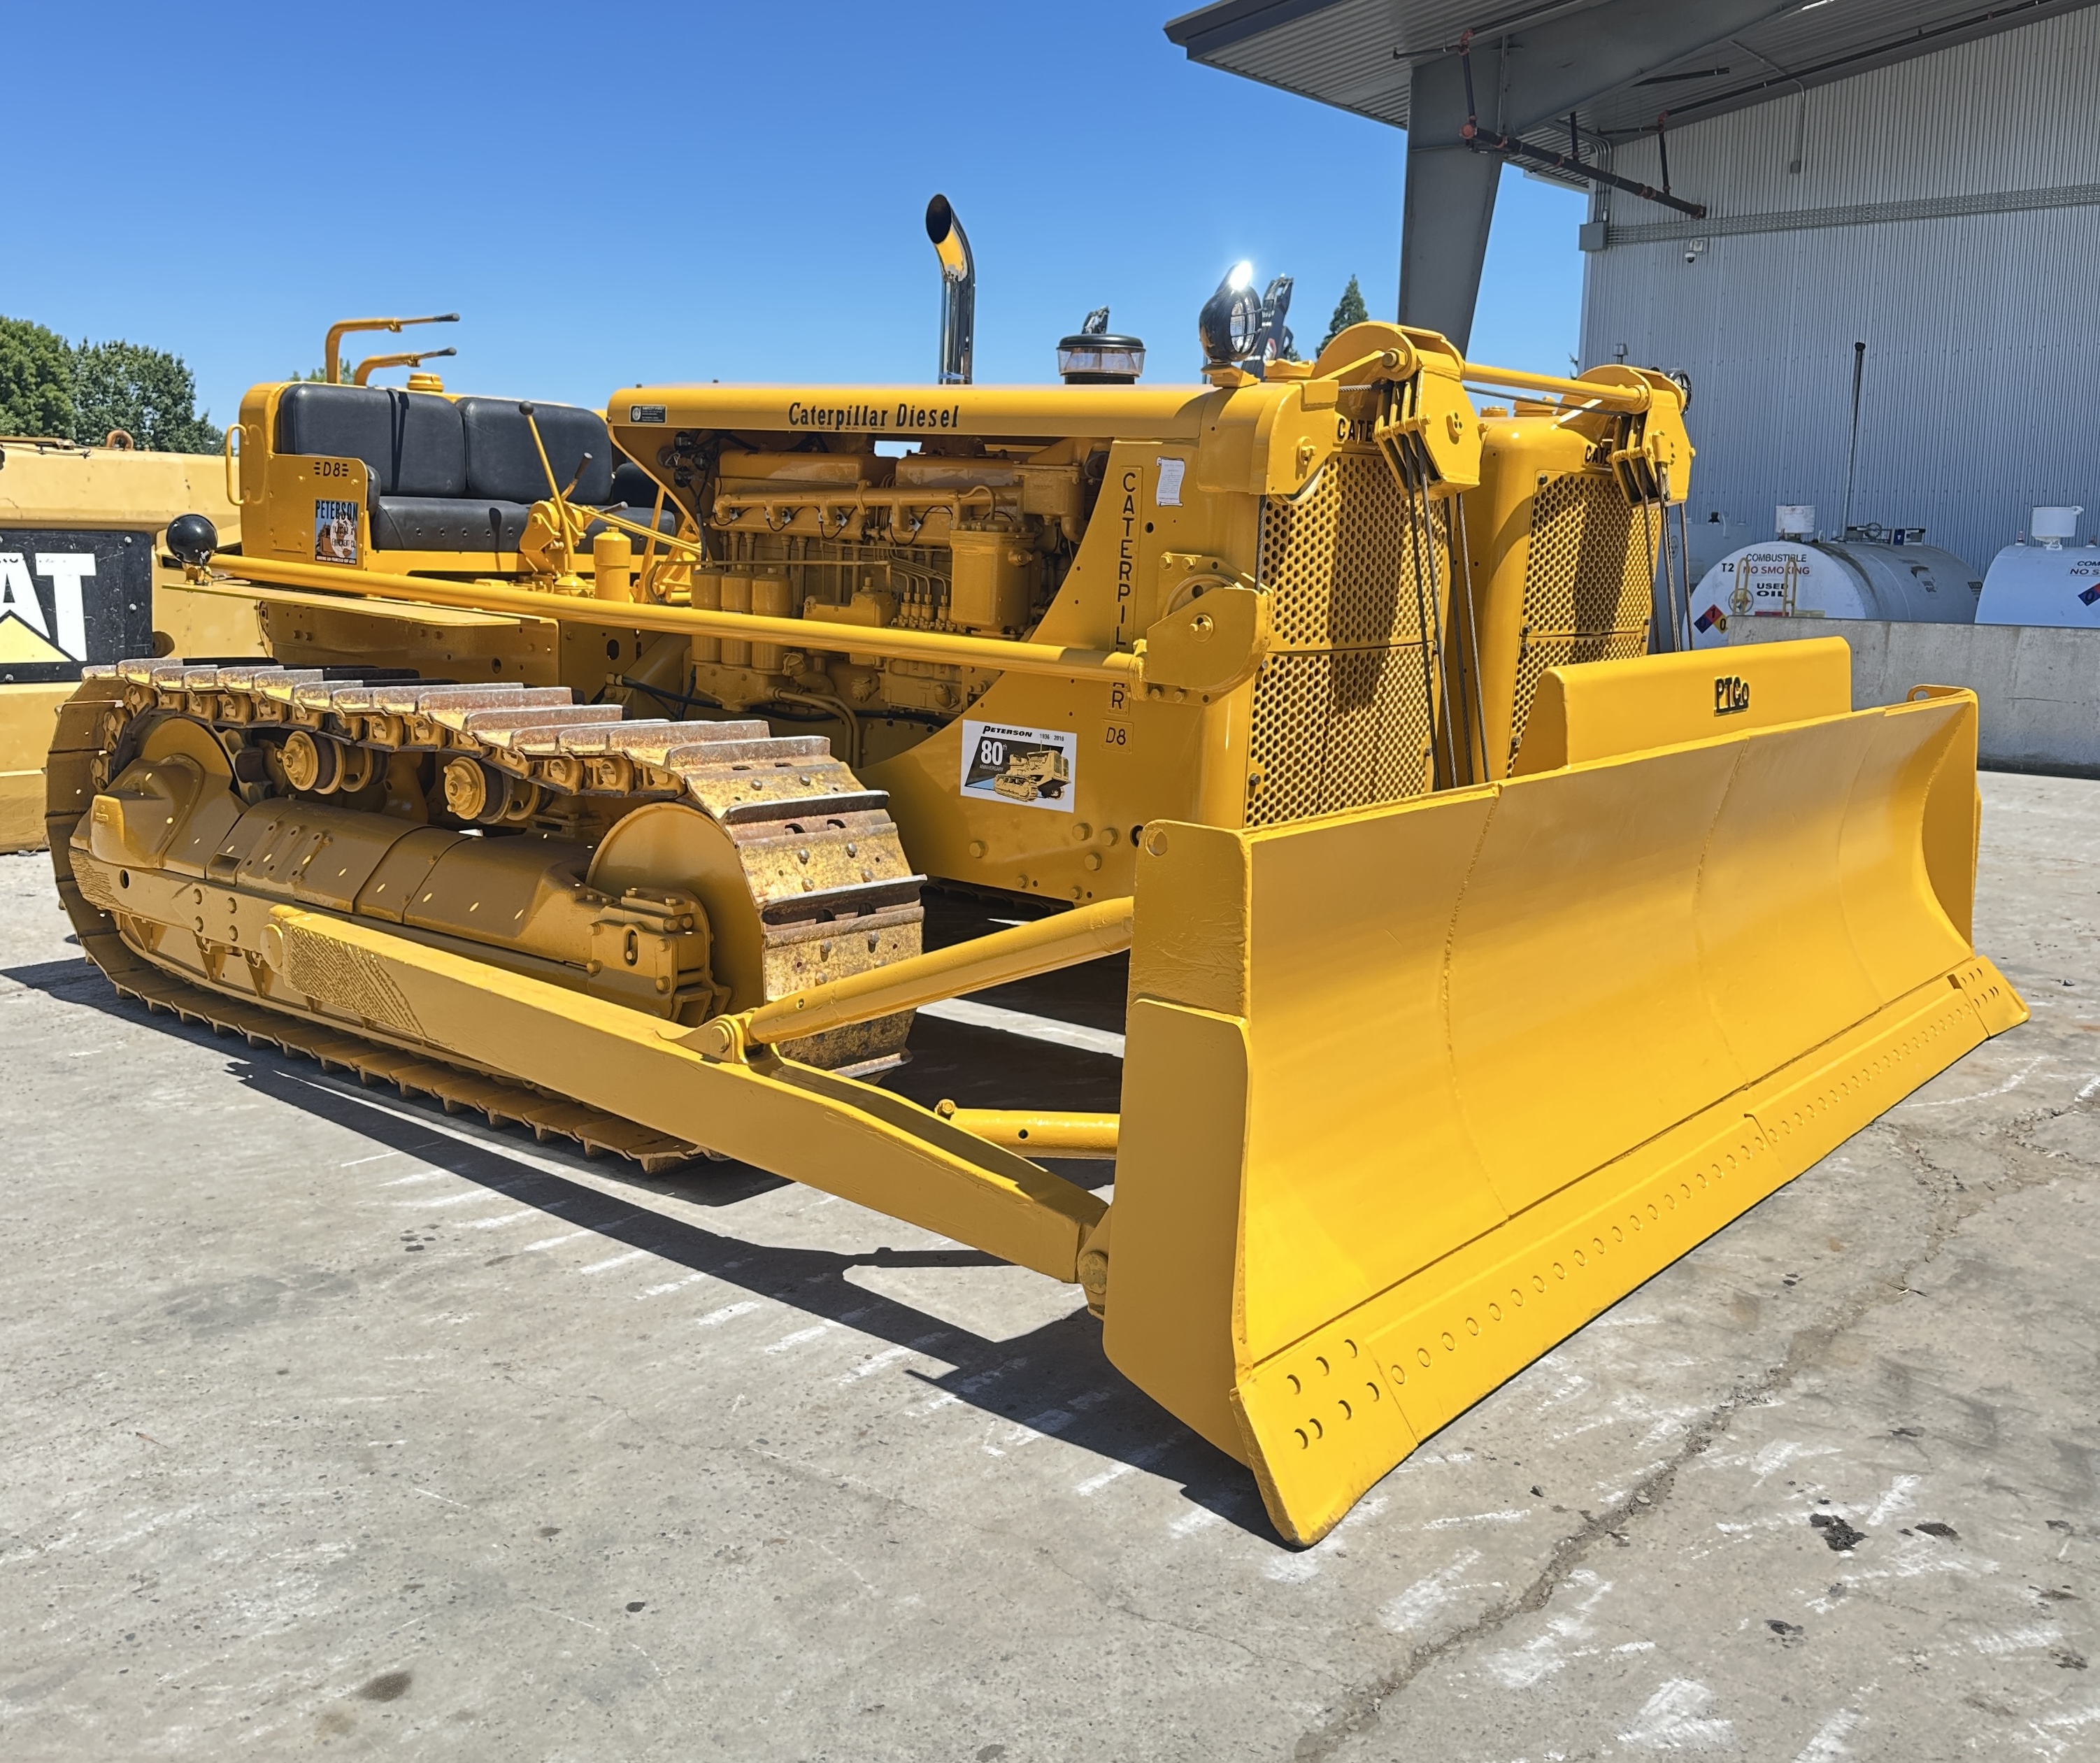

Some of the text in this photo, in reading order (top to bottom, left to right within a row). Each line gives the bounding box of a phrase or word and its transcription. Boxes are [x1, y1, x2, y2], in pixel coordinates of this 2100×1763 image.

[789, 402, 959, 430] Caterpillar Diesel
[323, 462, 341, 477] D8
[316, 500, 358, 522] PETERSON
[1746, 554, 1807, 562] COMBUSTIBLE
[1721, 563, 1734, 572] T2
[1761, 566, 1810, 574] SMOKING
[1111, 472, 1136, 709] CATERPILR
[1720, 618, 1727, 631] 0
[983, 725, 1033, 738] PETERSON
[1106, 727, 1126, 745] D8
